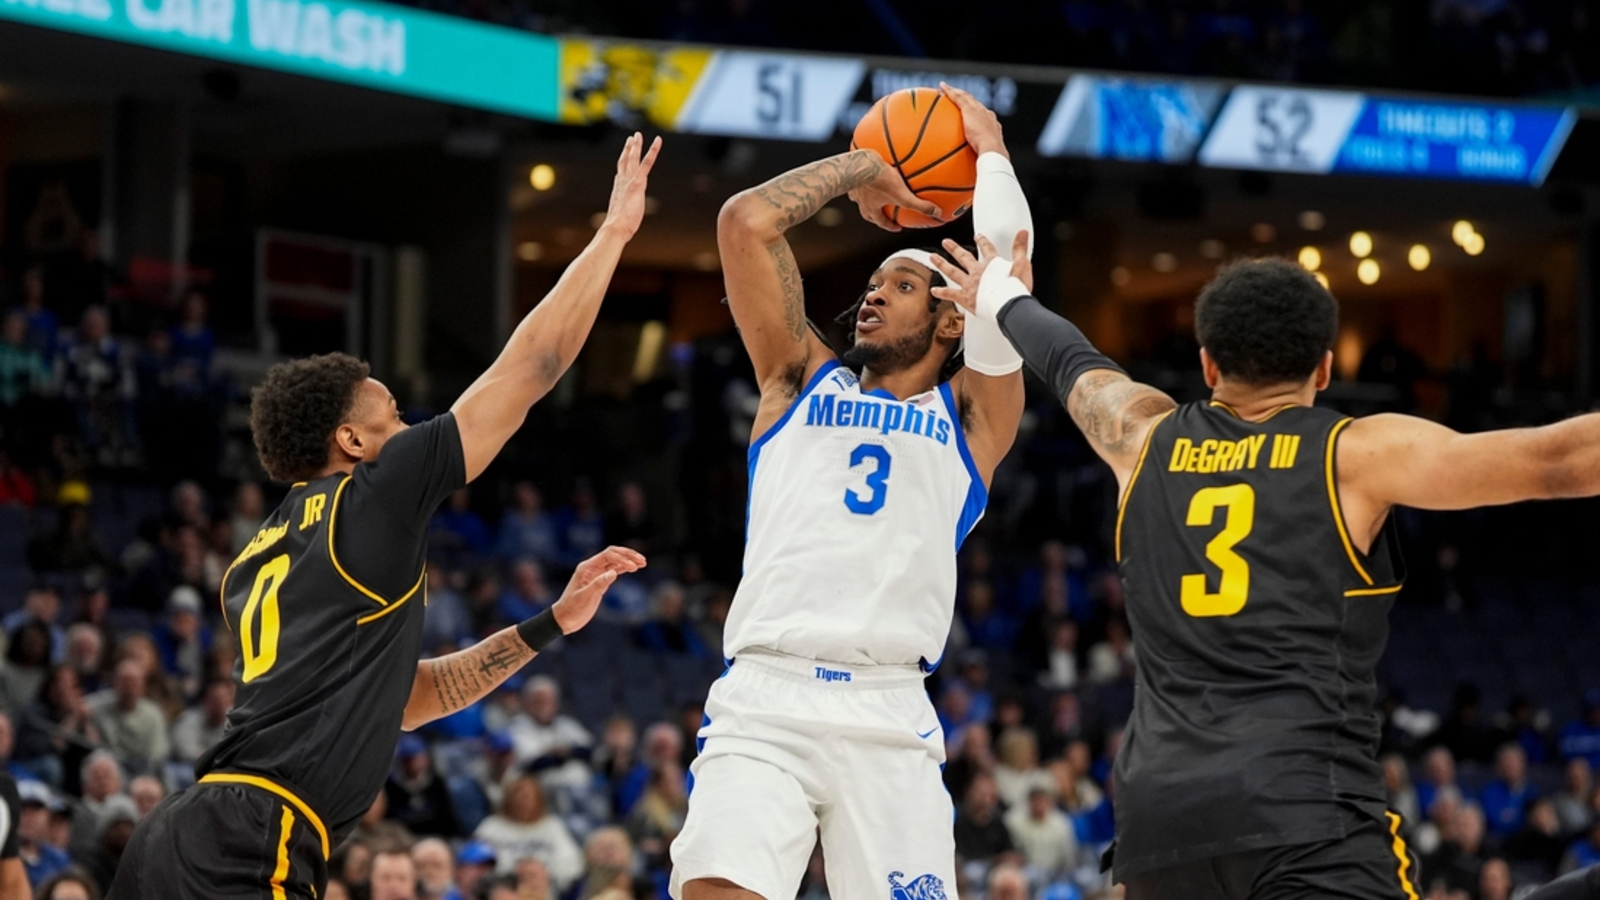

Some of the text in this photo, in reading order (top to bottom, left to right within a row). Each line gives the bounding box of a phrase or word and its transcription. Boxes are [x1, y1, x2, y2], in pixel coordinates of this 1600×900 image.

[246, 0, 406, 76] WASH
[755, 62, 804, 124] 51
[1255, 96, 1314, 162] 52
[804, 394, 951, 446] Memphis
[1269, 434, 1301, 468] III
[844, 443, 892, 515] 3
[299, 493, 327, 532] JR
[1180, 483, 1255, 617] 3
[240, 554, 291, 684] 0
[814, 666, 852, 683] Tigers
